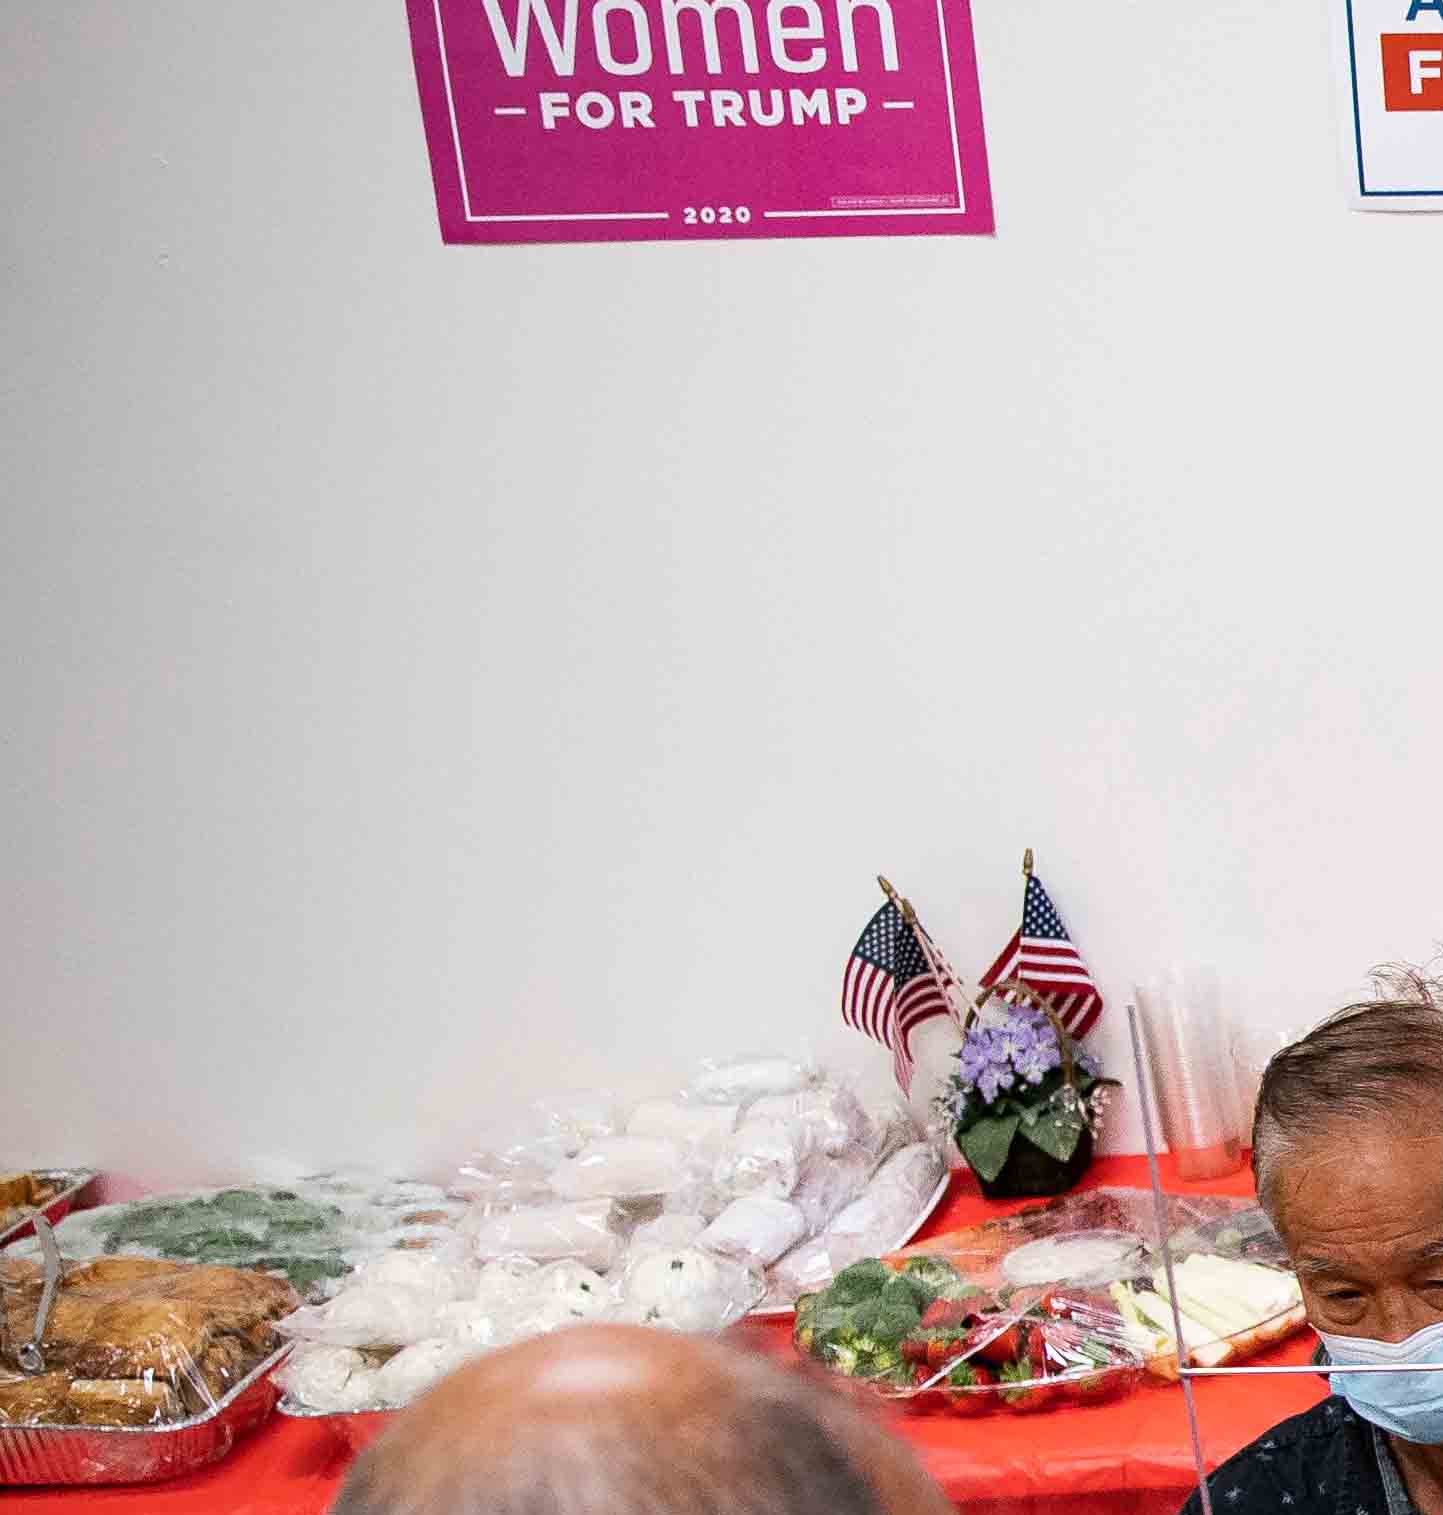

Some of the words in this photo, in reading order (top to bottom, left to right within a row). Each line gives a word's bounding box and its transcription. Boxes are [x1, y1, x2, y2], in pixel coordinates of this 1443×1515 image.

[539, 91, 656, 130] FOR
[673, 88, 869, 128] TRUMP
[683, 206, 752, 225] 2020
